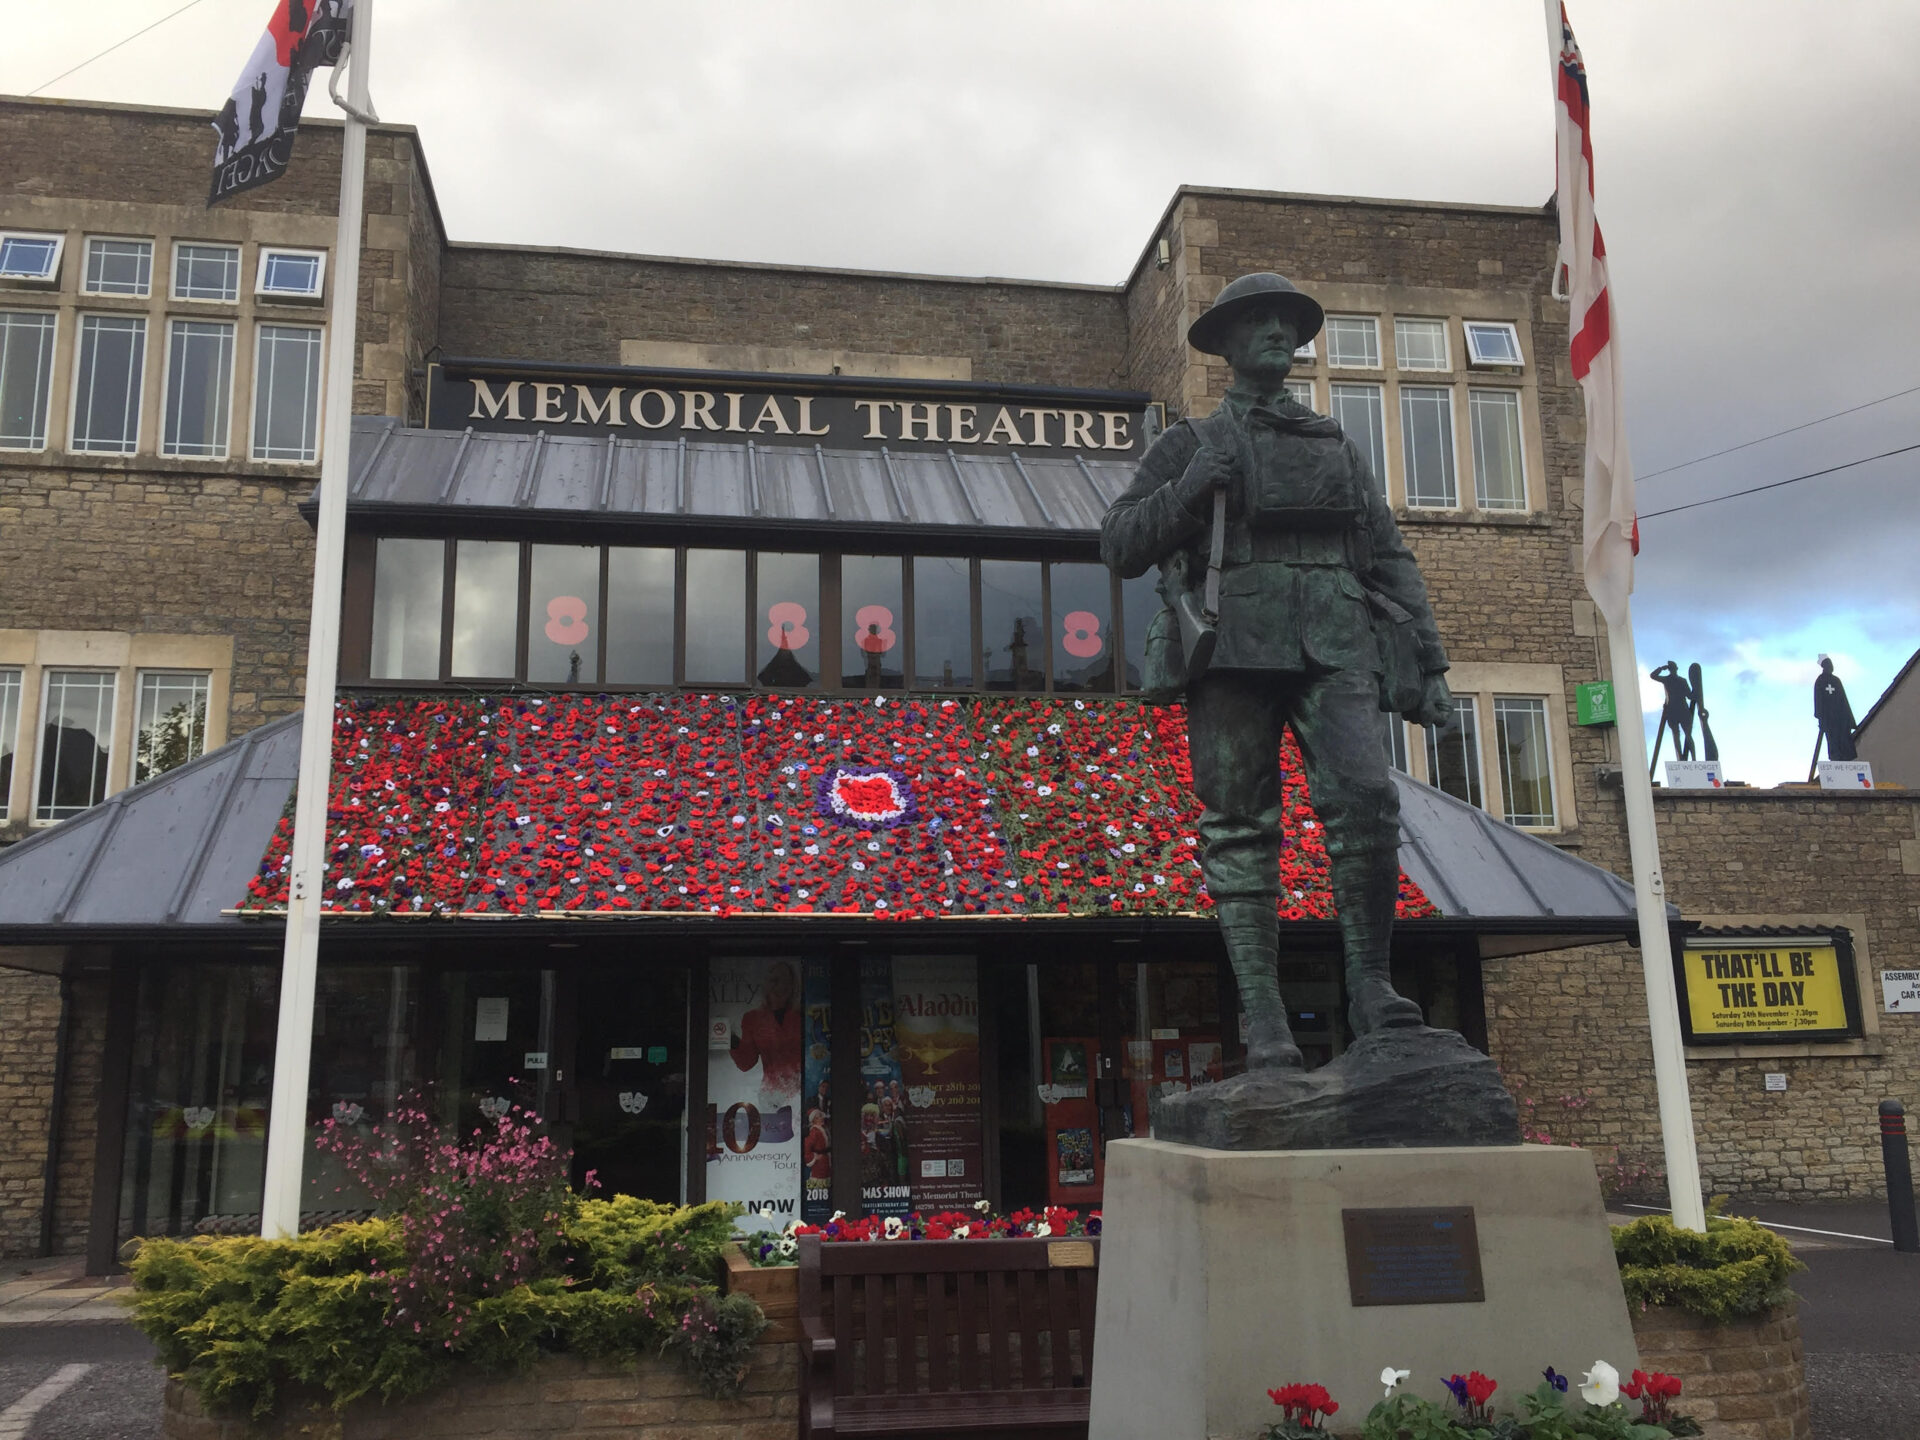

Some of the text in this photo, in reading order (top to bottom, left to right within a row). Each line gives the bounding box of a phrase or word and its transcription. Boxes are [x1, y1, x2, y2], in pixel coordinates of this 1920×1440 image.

[468, 379, 1134, 450] MEMORIAL THEATRE
[1701, 951, 1815, 979] THAT'LL BE
[1885, 972, 1919, 981] ASSEMBLY
[1718, 981, 1805, 1008] THE DAY
[1901, 991, 1915, 999] CAR
[1758, 1010, 1789, 1018] November
[1757, 1019, 1788, 1027] December
[527, 1057, 544, 1065] PULL
[706, 1102, 761, 1154] 10
[722, 1153, 792, 1163] Anniversary
[773, 1161, 797, 1170] Tour
[806, 1188, 829, 1201] 2018
[883, 1185, 911, 1199] SHOW
[923, 1191, 958, 1200] Memorial
[748, 1199, 795, 1214] NOW
